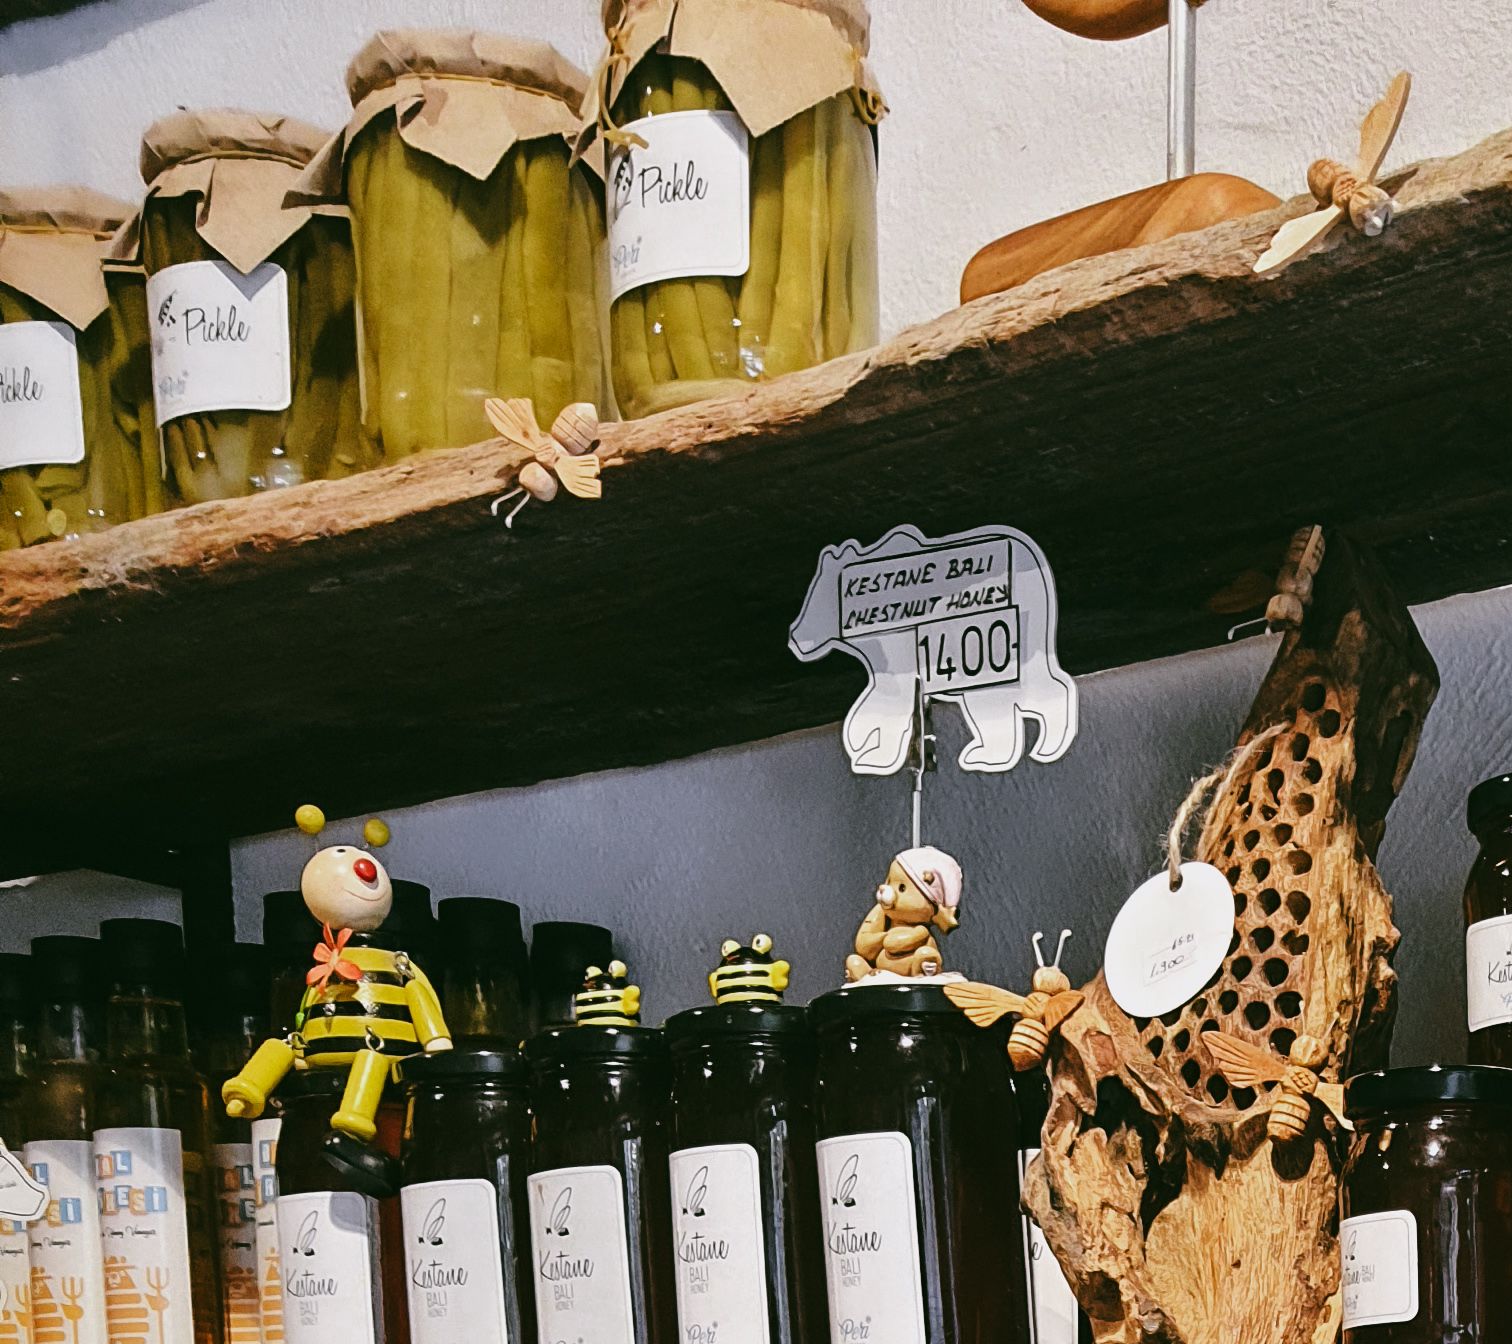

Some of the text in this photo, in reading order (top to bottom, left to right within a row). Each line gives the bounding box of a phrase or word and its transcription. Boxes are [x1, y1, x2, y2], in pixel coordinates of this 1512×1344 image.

[639, 160, 709, 208] Pickle
[182, 304, 250, 345] Pickle
[844, 554, 994, 598] KESTANE BALI
[843, 584, 1009, 631] CHESTNUT HONEY
[677, 1229, 730, 1264] Kestane
[827, 1222, 883, 1255] Kestane
[286, 1268, 338, 1298] Kestane
[412, 1258, 468, 1290] Kestane
[539, 1249, 595, 1282] Kestane
